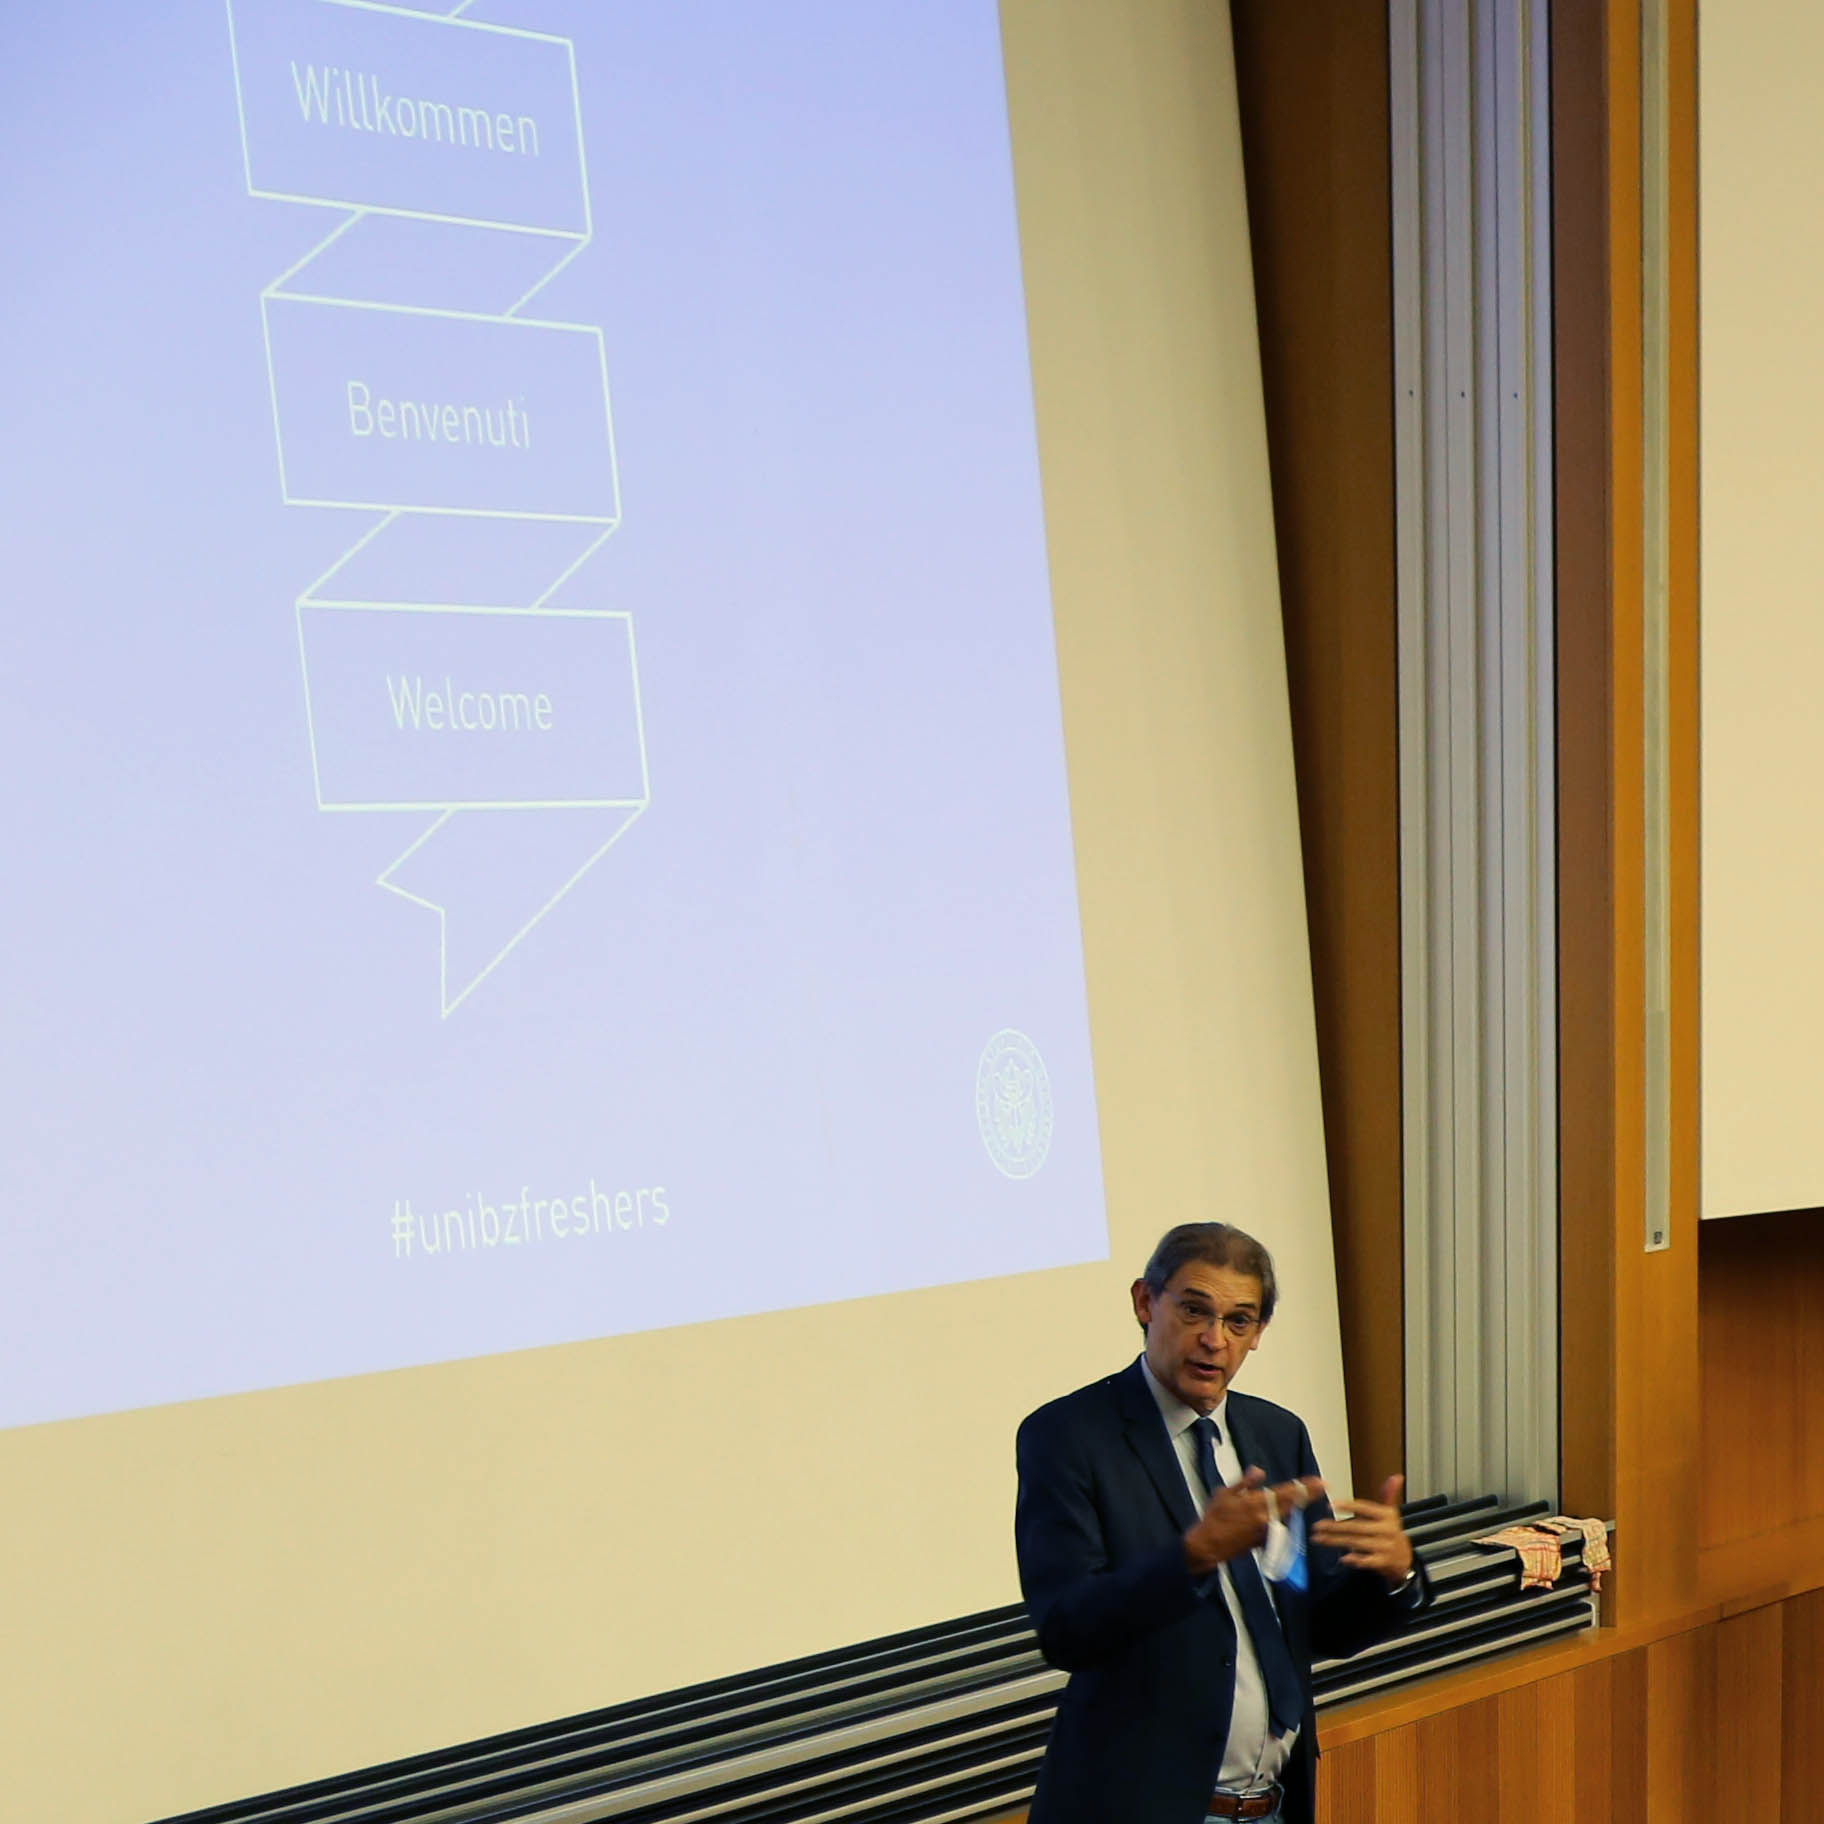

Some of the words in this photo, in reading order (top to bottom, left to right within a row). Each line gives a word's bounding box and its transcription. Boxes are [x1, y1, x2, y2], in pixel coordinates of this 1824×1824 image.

[290, 60, 540, 157] Willkommen
[346, 379, 530, 449] Benvenuti
[385, 672, 554, 731] Welcome
[390, 1177, 670, 1258] #unibzfreshers
